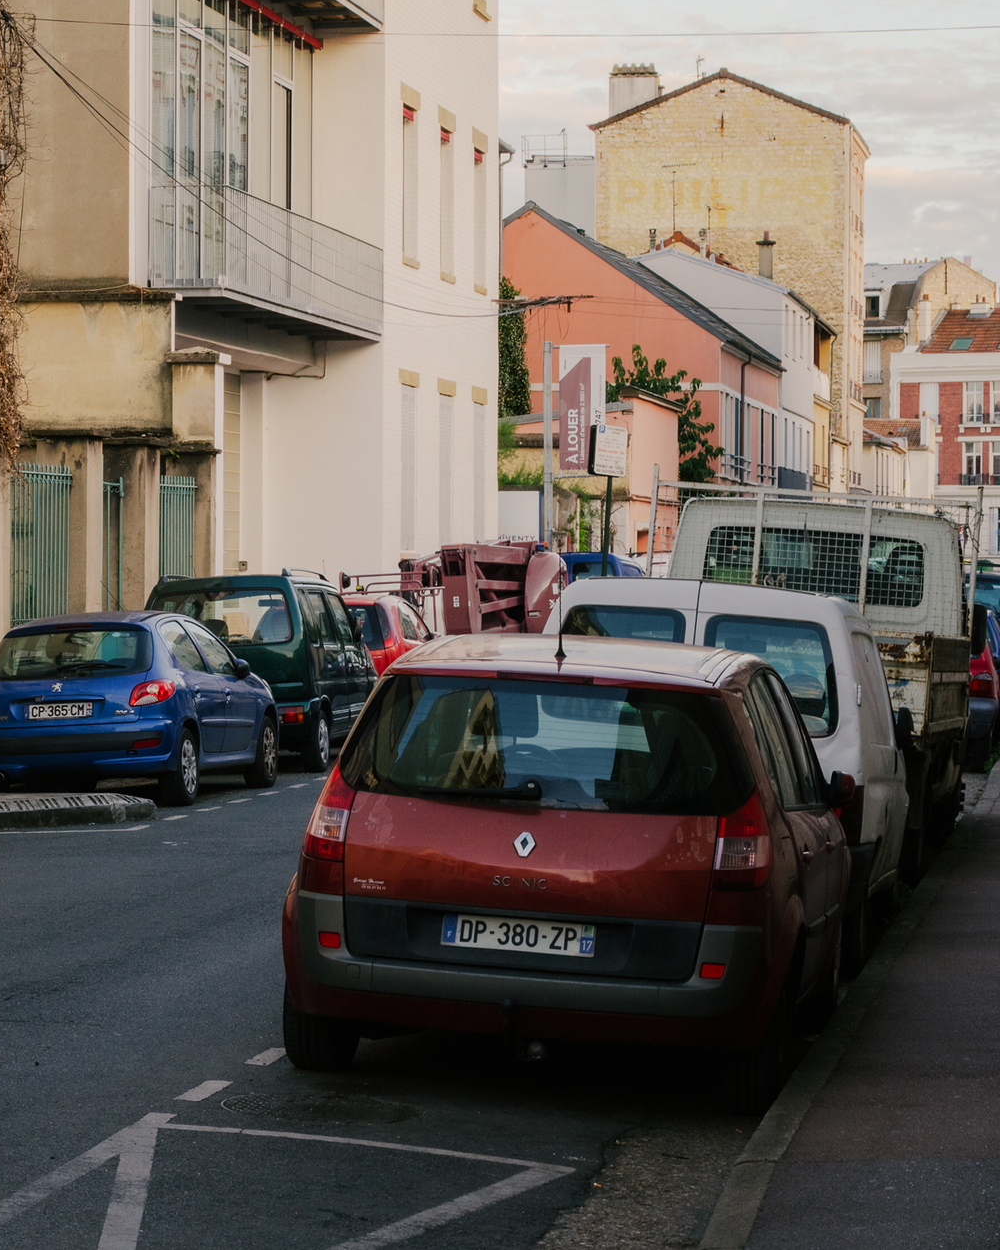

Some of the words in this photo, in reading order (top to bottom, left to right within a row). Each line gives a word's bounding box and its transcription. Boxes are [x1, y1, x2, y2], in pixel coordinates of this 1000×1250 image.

[579, 382, 585, 390] m²
[579, 406, 585, 414] de
[568, 408, 578, 451] LOUER
[565, 453, 579, 464] À
[31, 704, 85, 718] CP-365-CM
[492, 875, 547, 890] SCNIC
[447, 930, 453, 938] F
[459, 919, 578, 951] DP-380-ZP
[582, 939, 593, 952] 17
